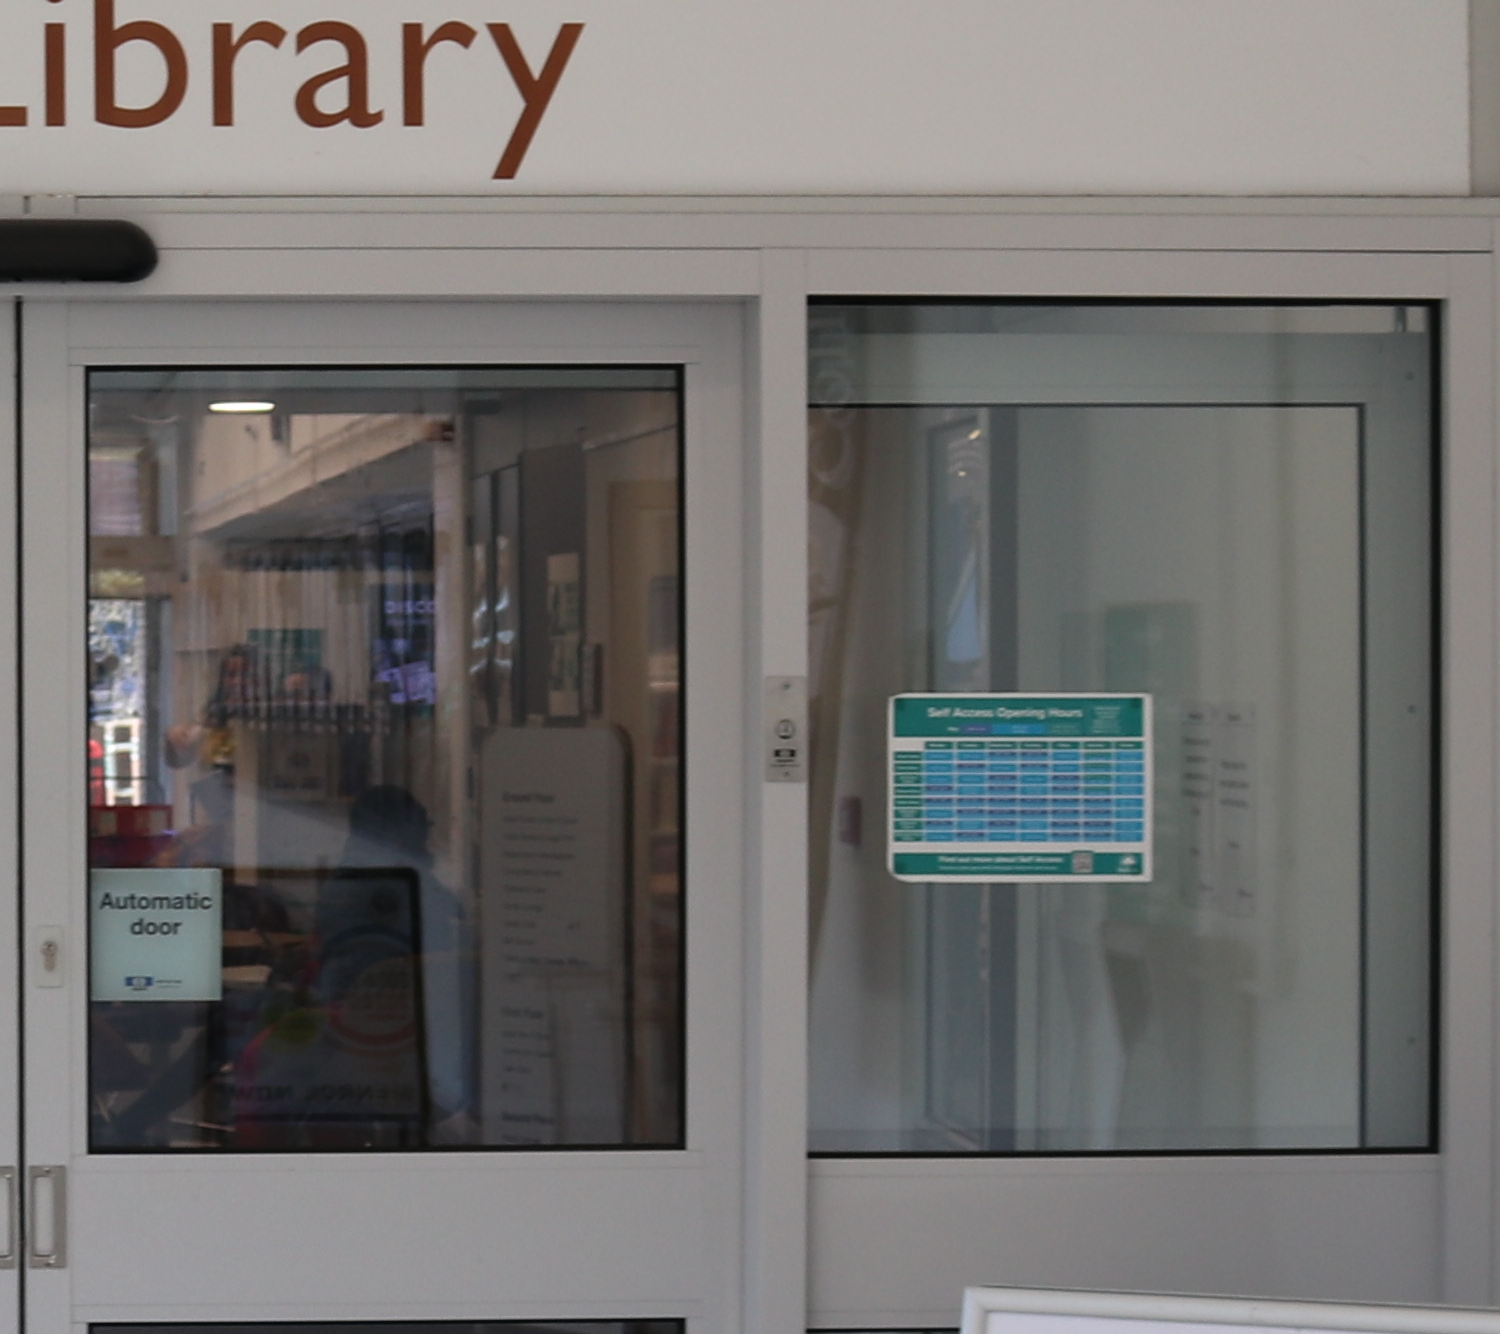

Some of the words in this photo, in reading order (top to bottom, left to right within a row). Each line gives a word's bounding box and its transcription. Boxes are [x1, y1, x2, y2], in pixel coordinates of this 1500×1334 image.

[927, 707, 953, 718] Self
[954, 707, 994, 718] Access
[996, 707, 1046, 720] Opening
[1050, 707, 1083, 718] Hours
[100, 891, 213, 911] Automatic
[130, 917, 182, 936] door
